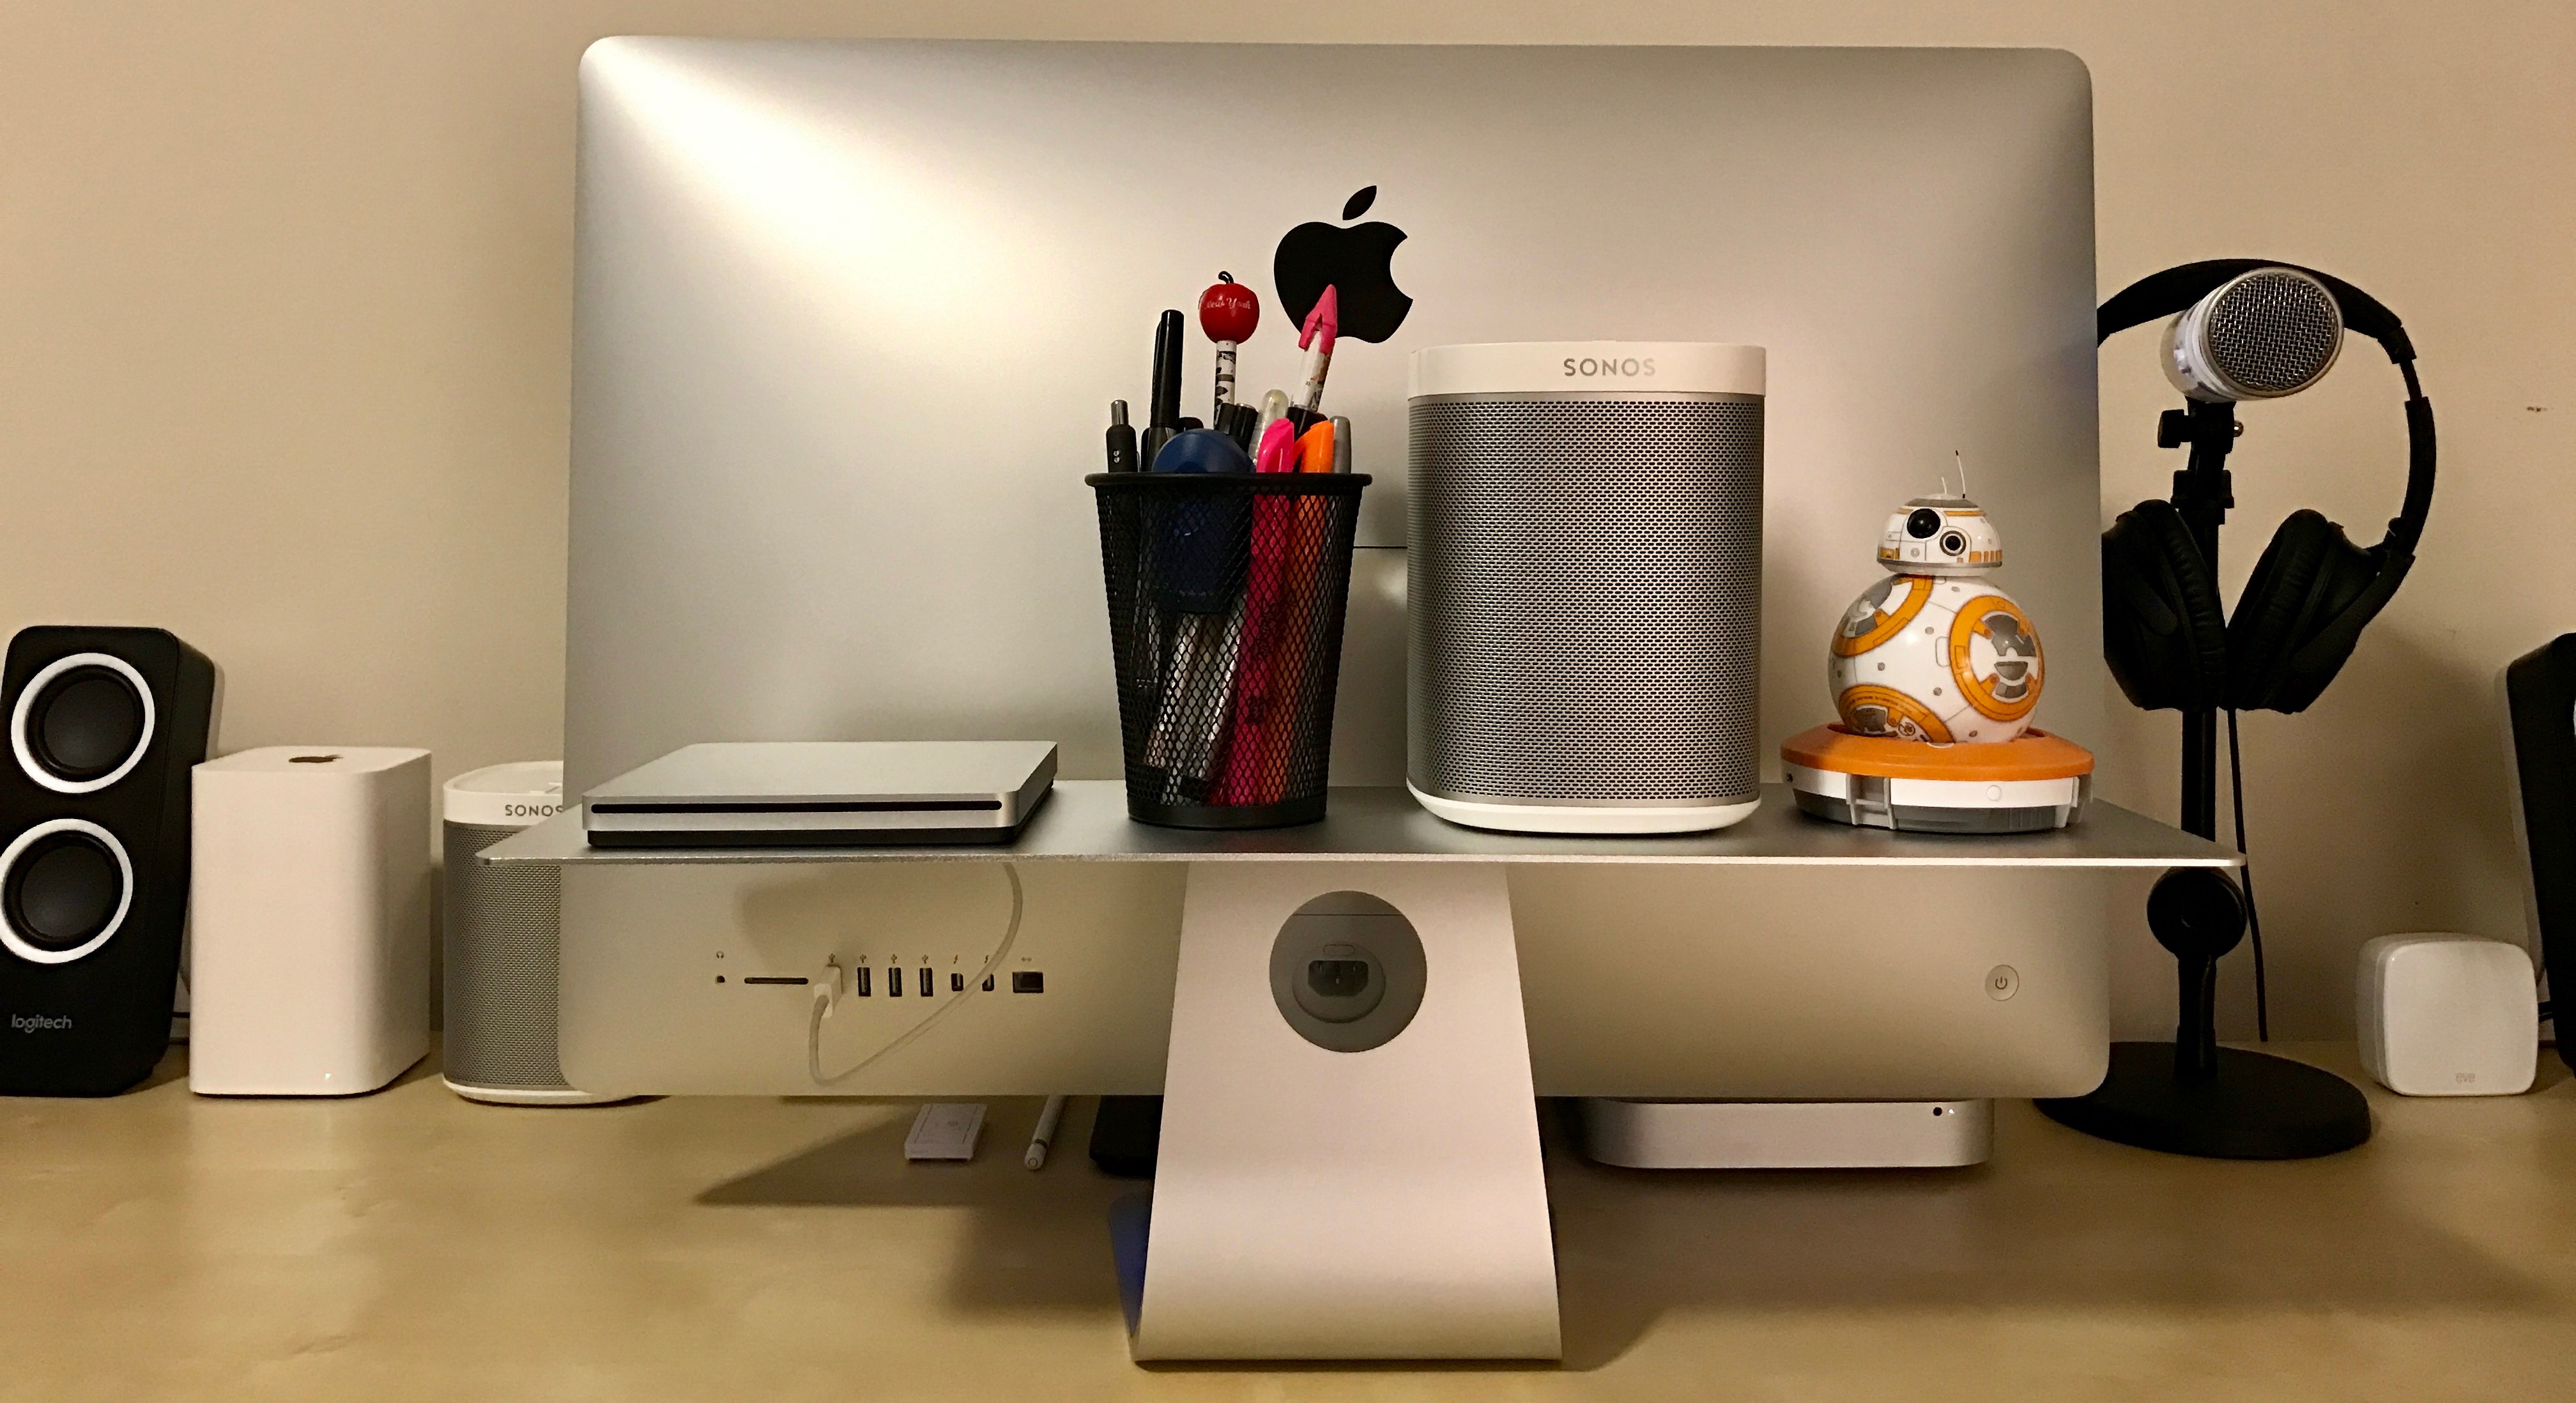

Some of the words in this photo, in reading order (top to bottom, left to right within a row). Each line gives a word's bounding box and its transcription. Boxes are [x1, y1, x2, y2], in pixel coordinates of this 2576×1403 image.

[1563, 358, 1655, 376] SONOS
[11, 1013, 72, 1034] logitech
[2455, 1072, 2476, 1084] eve
